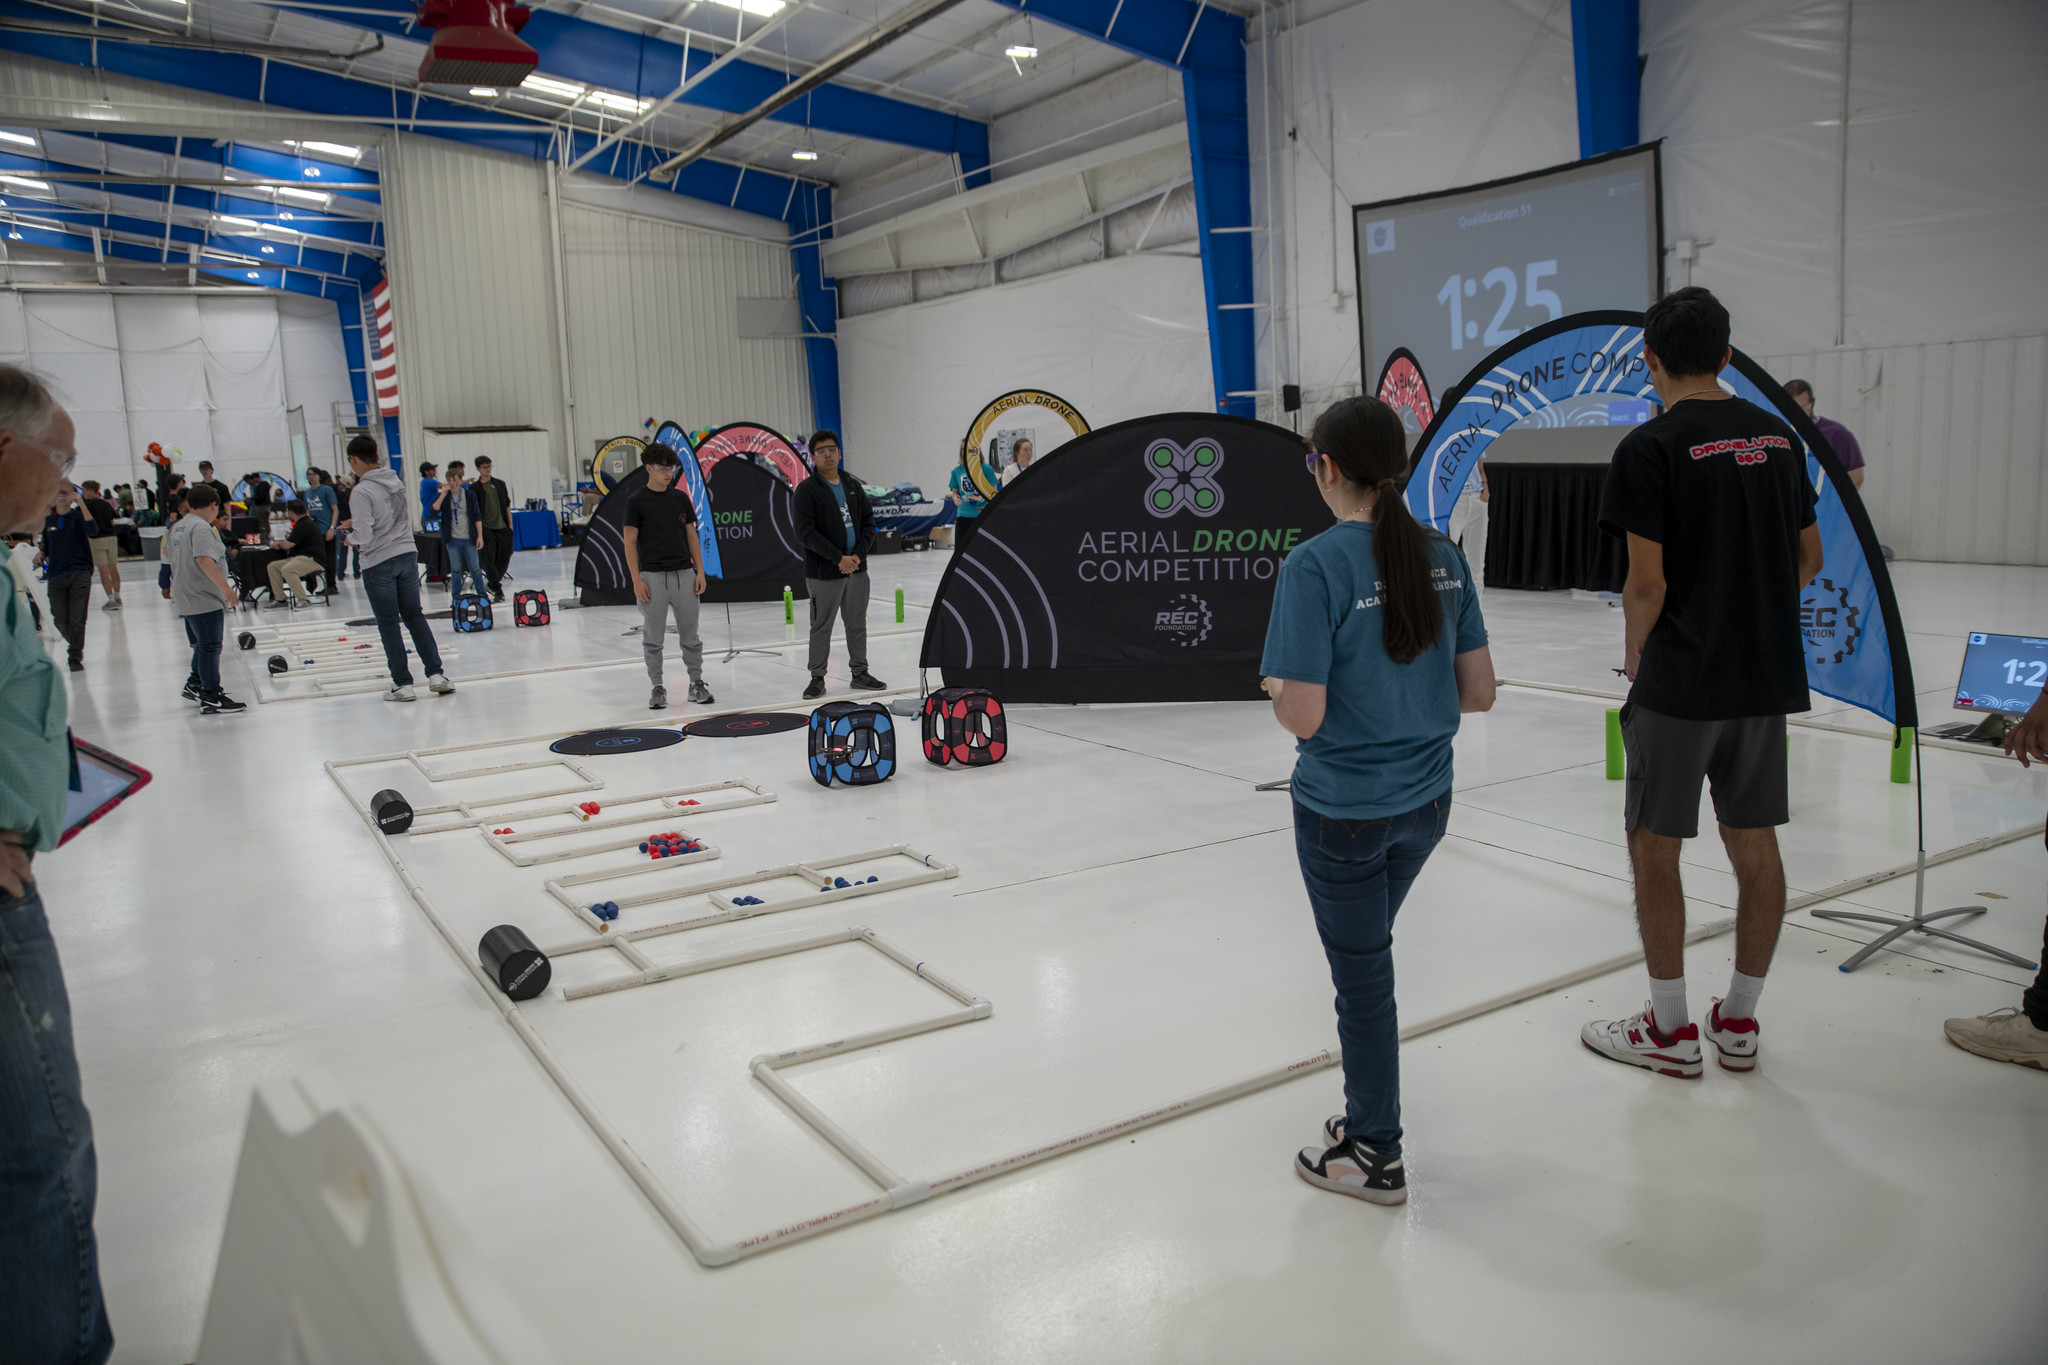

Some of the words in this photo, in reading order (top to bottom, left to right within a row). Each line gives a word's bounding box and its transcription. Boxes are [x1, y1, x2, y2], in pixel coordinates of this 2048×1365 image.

[1459, 208, 1518, 229] Qualification
[1521, 204, 1532, 217] 51
[1437, 259, 1563, 350] 1:25
[993, 395, 1032, 415] AERIAL
[1034, 396, 1075, 419] DRONE
[1438, 412, 1491, 493] AERIAL
[1491, 357, 1566, 414] DRONE
[1690, 436, 1791, 459] DRONELUTION
[1735, 450, 1767, 465] 360
[426, 521, 440, 532] 45
[714, 510, 752, 524] RONE
[247, 534, 260, 545] 35
[717, 526, 753, 540] TION
[1078, 530, 1189, 554] AERIAL
[1193, 528, 1302, 552] DRONE
[1156, 611, 1199, 625] REC
[1800, 607, 1837, 627] EC
[1801, 629, 1835, 638] DATION
[2003, 658, 2048, 688] 1:2
[1627, 1028, 1645, 1045] N
[1287, 1053, 1330, 1072] CHARLOTTE
[776, 1211, 840, 1238] CHARLOTTE
